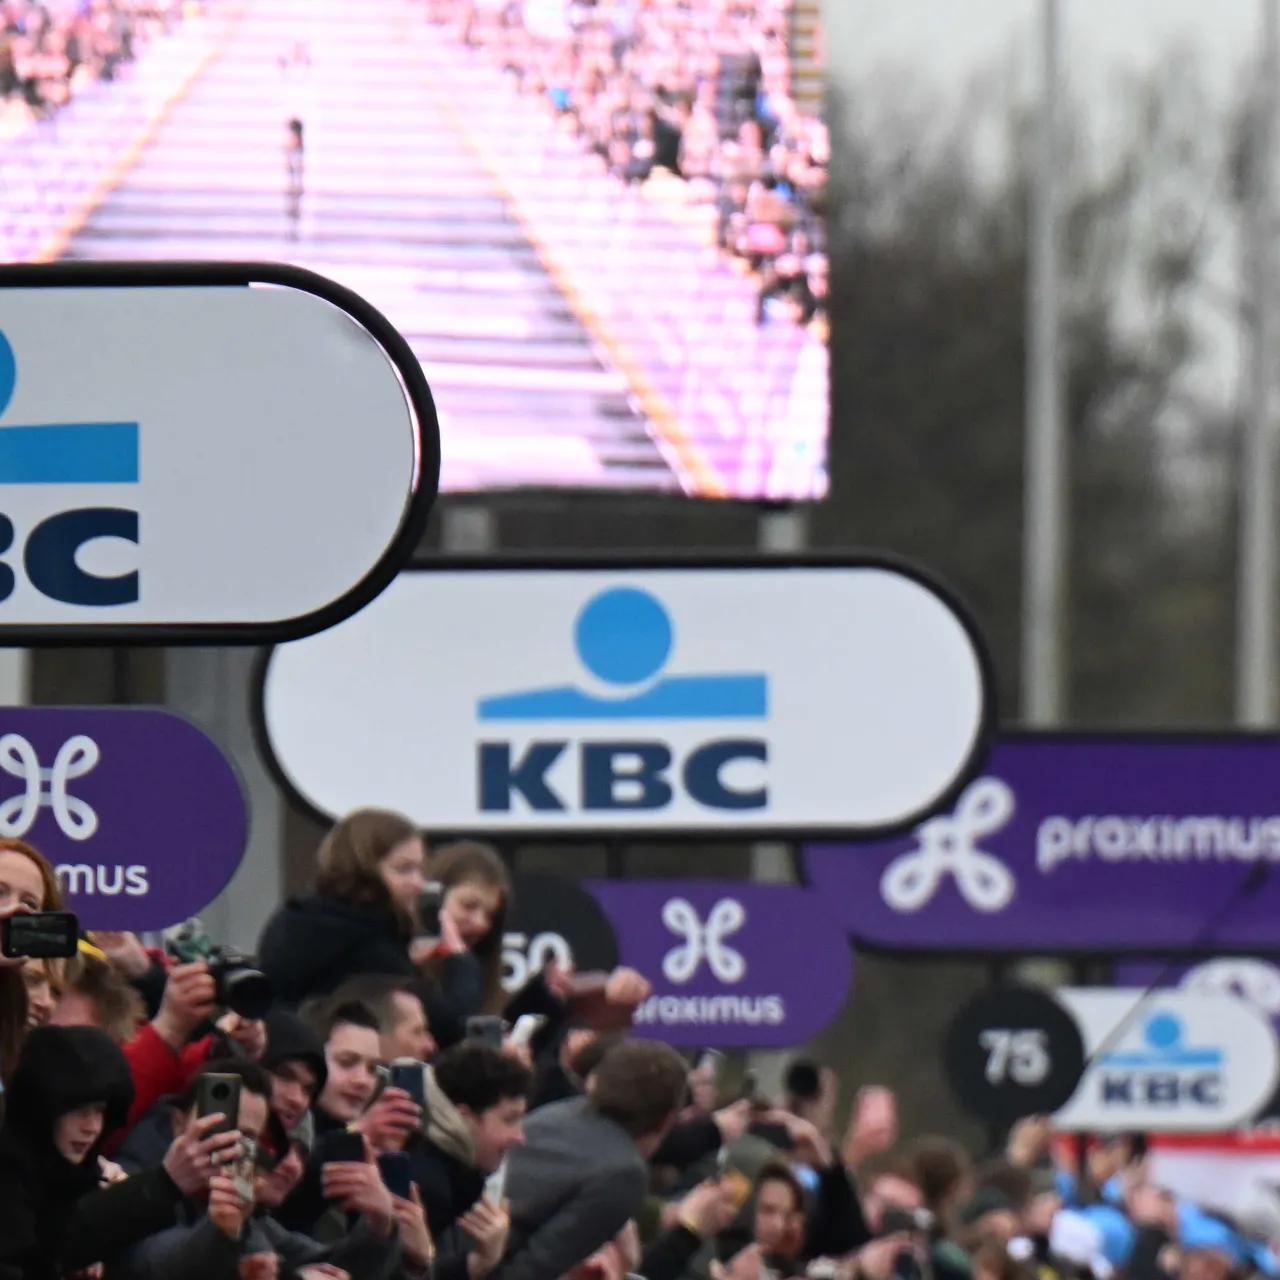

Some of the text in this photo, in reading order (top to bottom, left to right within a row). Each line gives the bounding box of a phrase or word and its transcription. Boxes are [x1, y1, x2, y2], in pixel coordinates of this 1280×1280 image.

[0, 507, 139, 607] C
[476, 738, 769, 812] KBC
[978, 1029, 1052, 1086] 75
[1102, 1073, 1221, 1103] KBC
